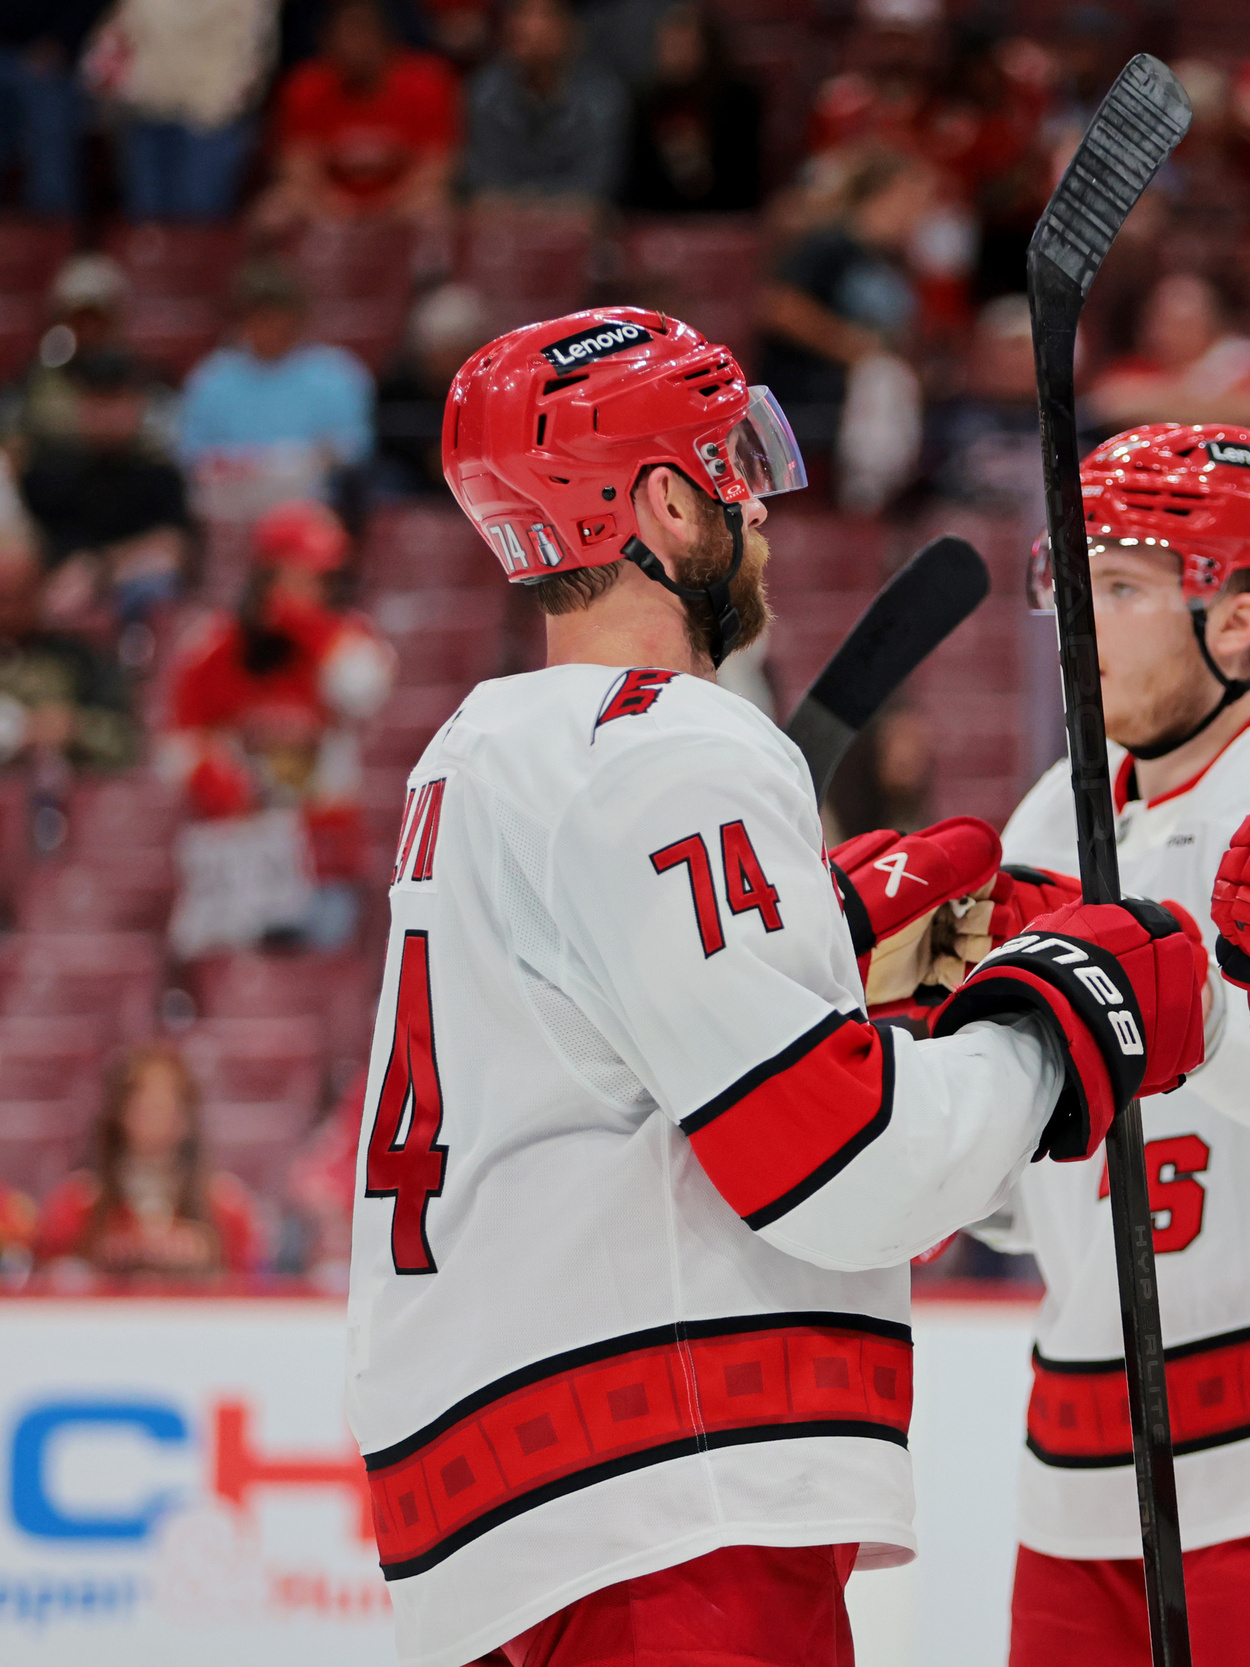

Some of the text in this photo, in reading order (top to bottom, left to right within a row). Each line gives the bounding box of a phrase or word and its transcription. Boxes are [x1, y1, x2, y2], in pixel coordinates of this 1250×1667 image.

[553, 323, 639, 366] Lenovo
[489, 523, 529, 572] 74
[649, 819, 785, 960] 74
[364, 929, 449, 1276] 4
